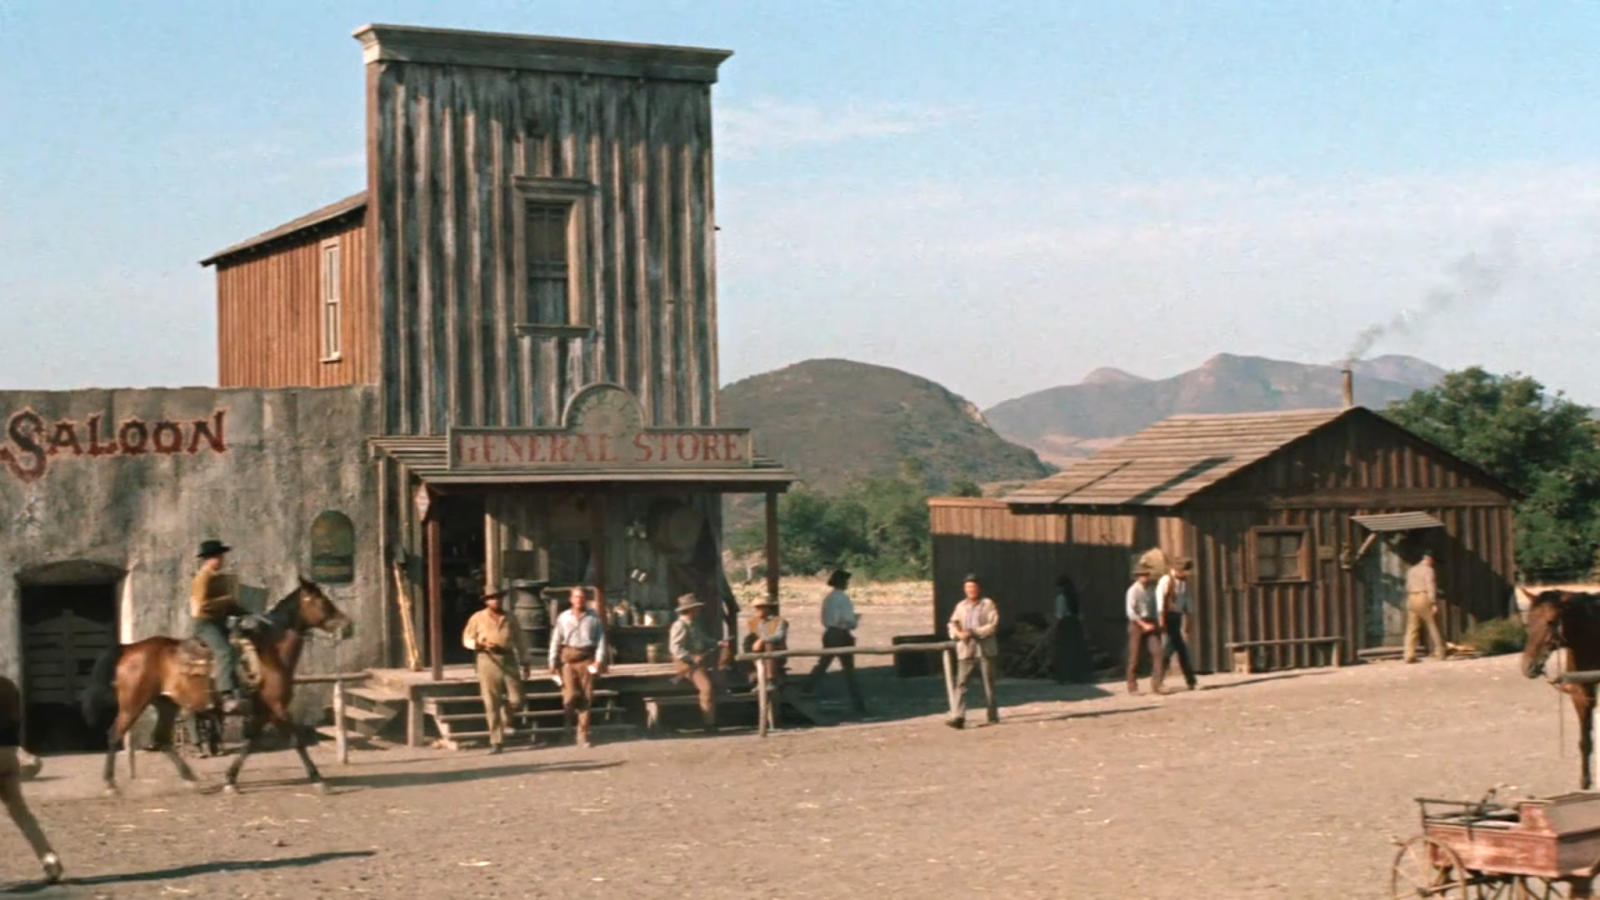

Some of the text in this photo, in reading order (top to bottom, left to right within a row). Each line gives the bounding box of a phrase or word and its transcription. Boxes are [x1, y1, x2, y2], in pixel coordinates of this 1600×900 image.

[0, 406, 229, 483] SALOON
[457, 430, 743, 463] GENERAL STORE
